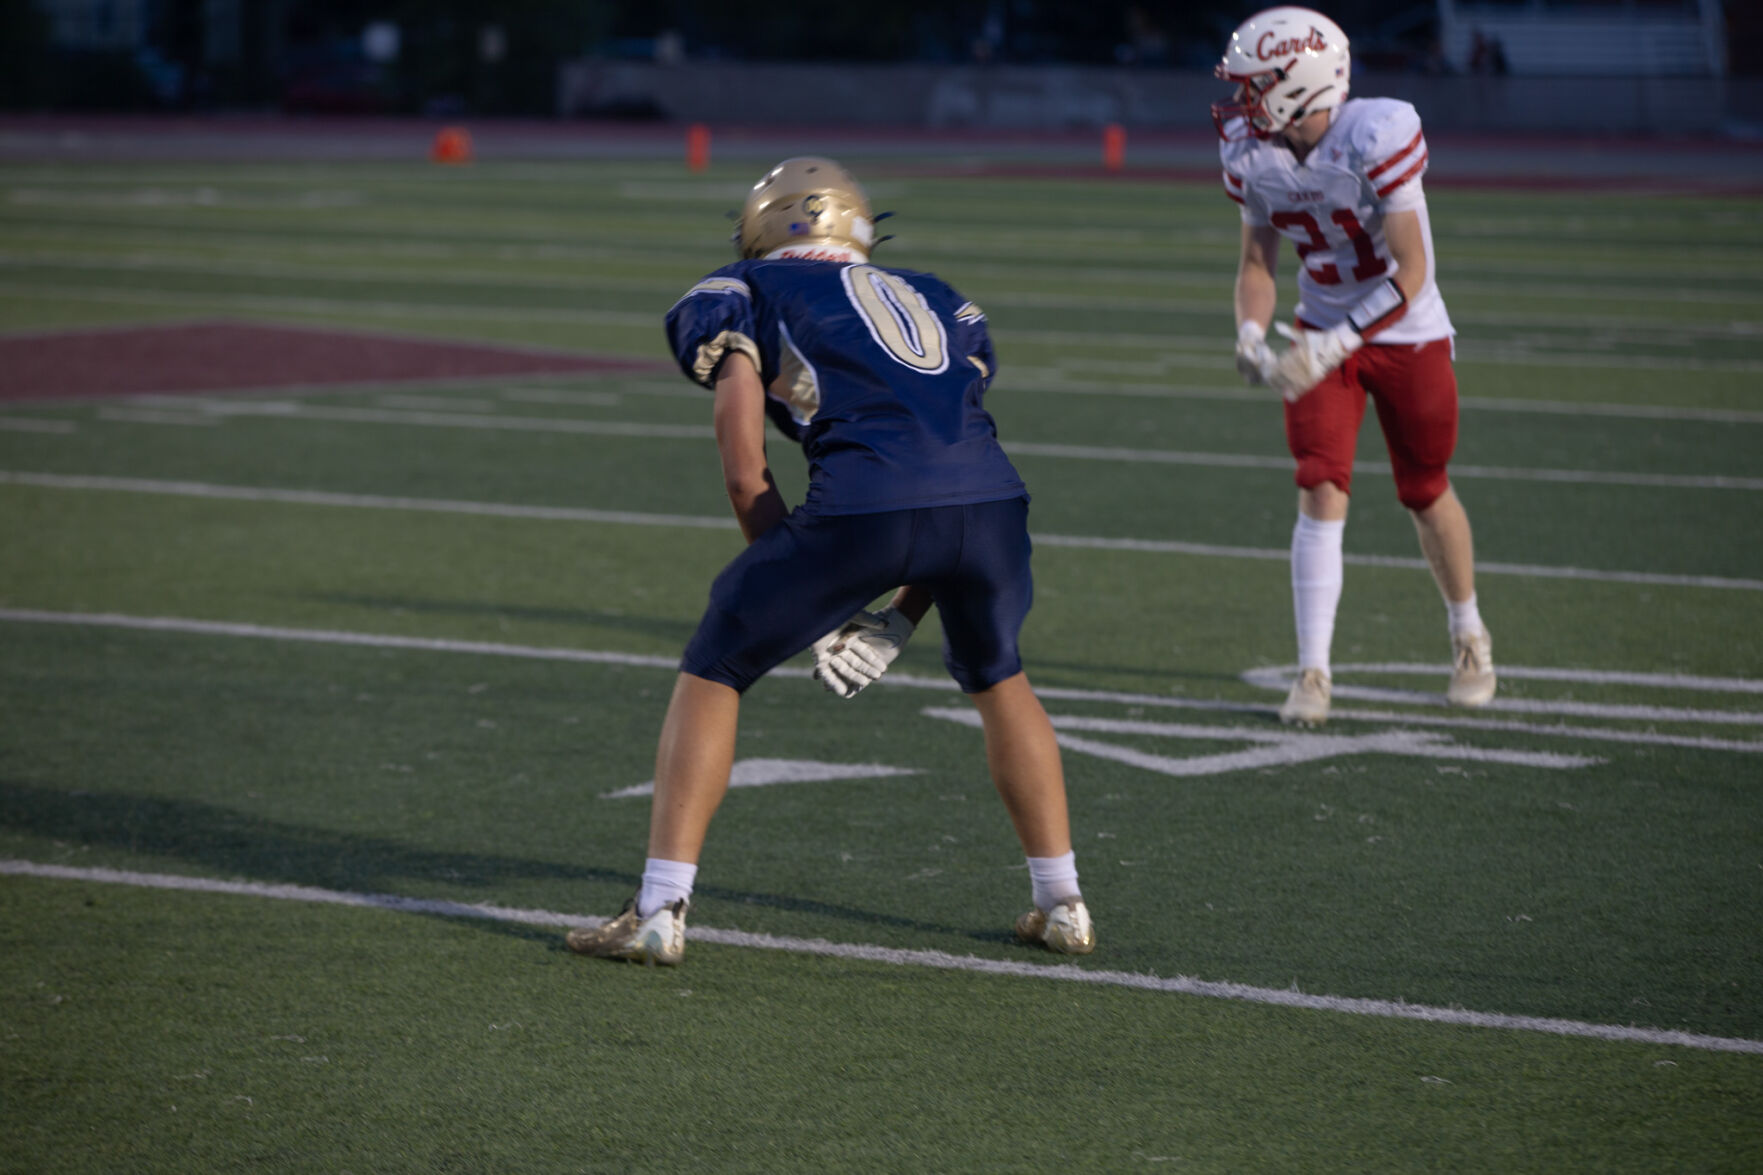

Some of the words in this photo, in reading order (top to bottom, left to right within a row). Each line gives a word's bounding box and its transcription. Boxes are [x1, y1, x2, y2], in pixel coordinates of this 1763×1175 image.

[1256, 27, 1326, 62] Cards
[1270, 207, 1388, 285] 21
[840, 263, 950, 375] 0
